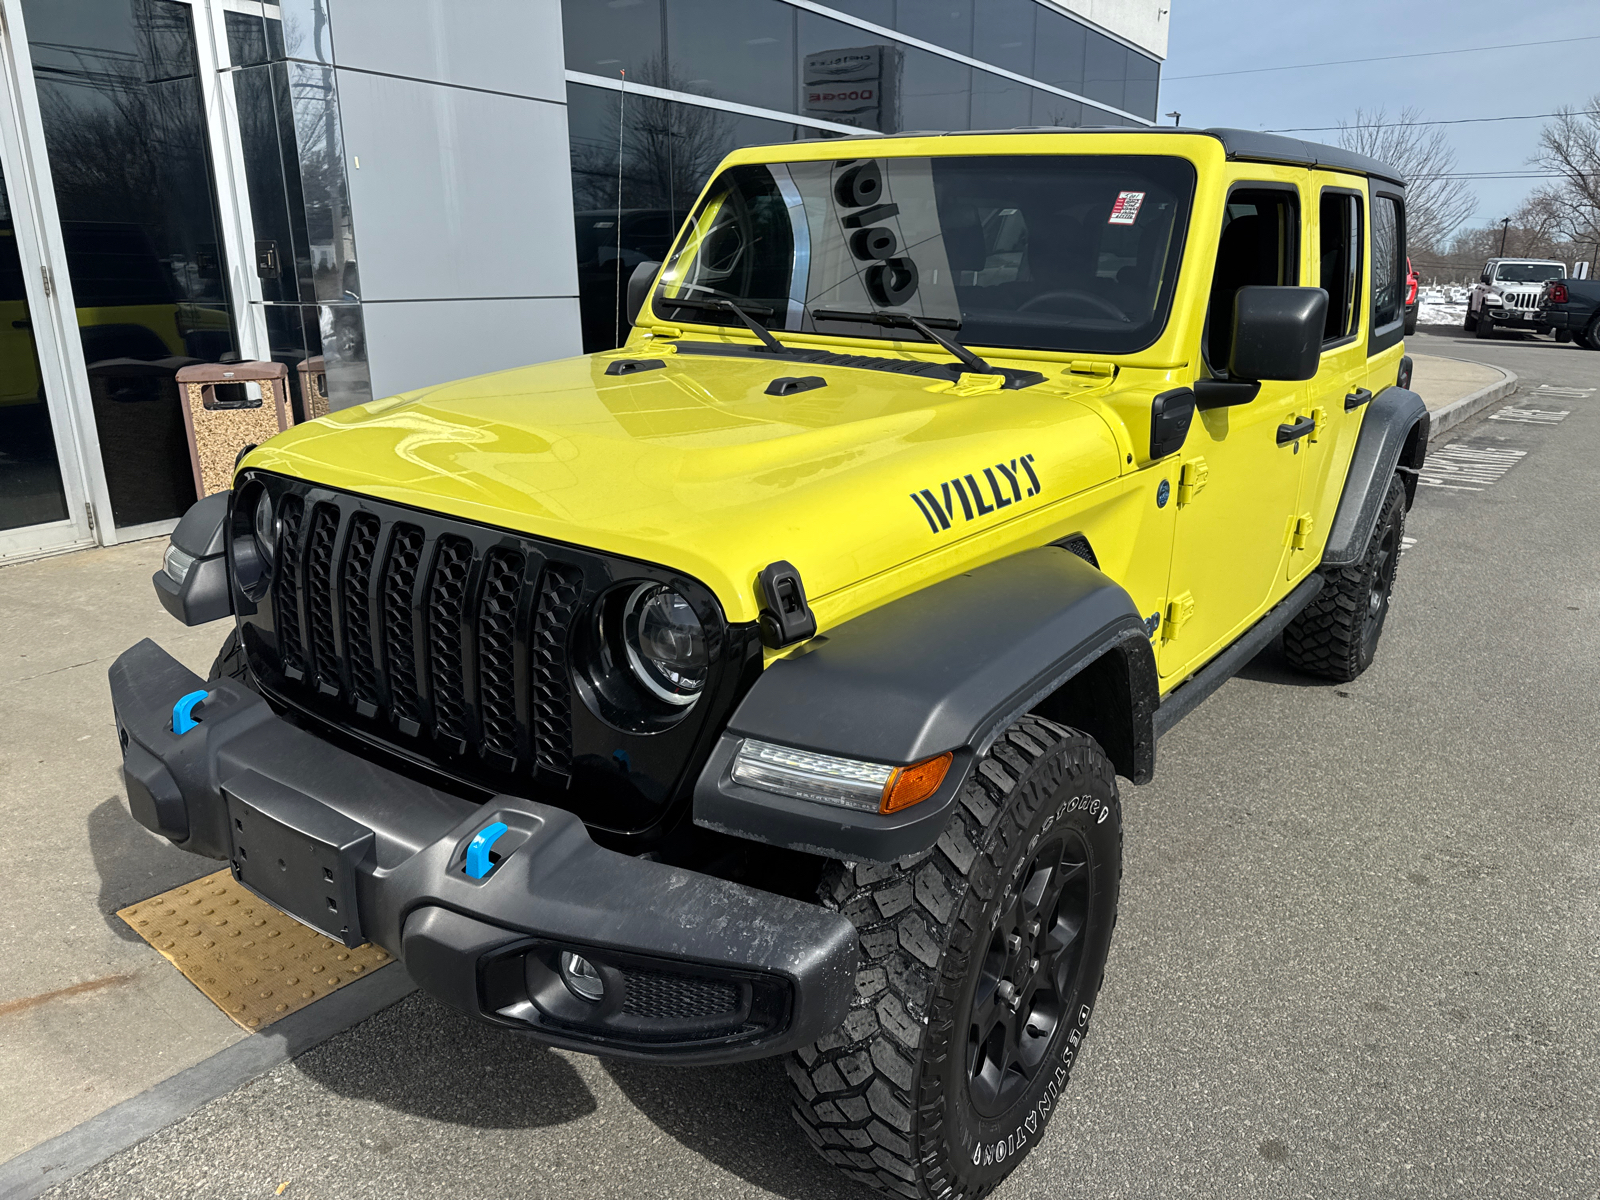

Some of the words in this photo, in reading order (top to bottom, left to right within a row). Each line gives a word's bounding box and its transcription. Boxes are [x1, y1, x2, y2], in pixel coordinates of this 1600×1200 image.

[909, 453, 1041, 534] WILLYS
[1417, 444, 1528, 491] PARKING
[982, 1004, 1091, 1167] DESTINATION
